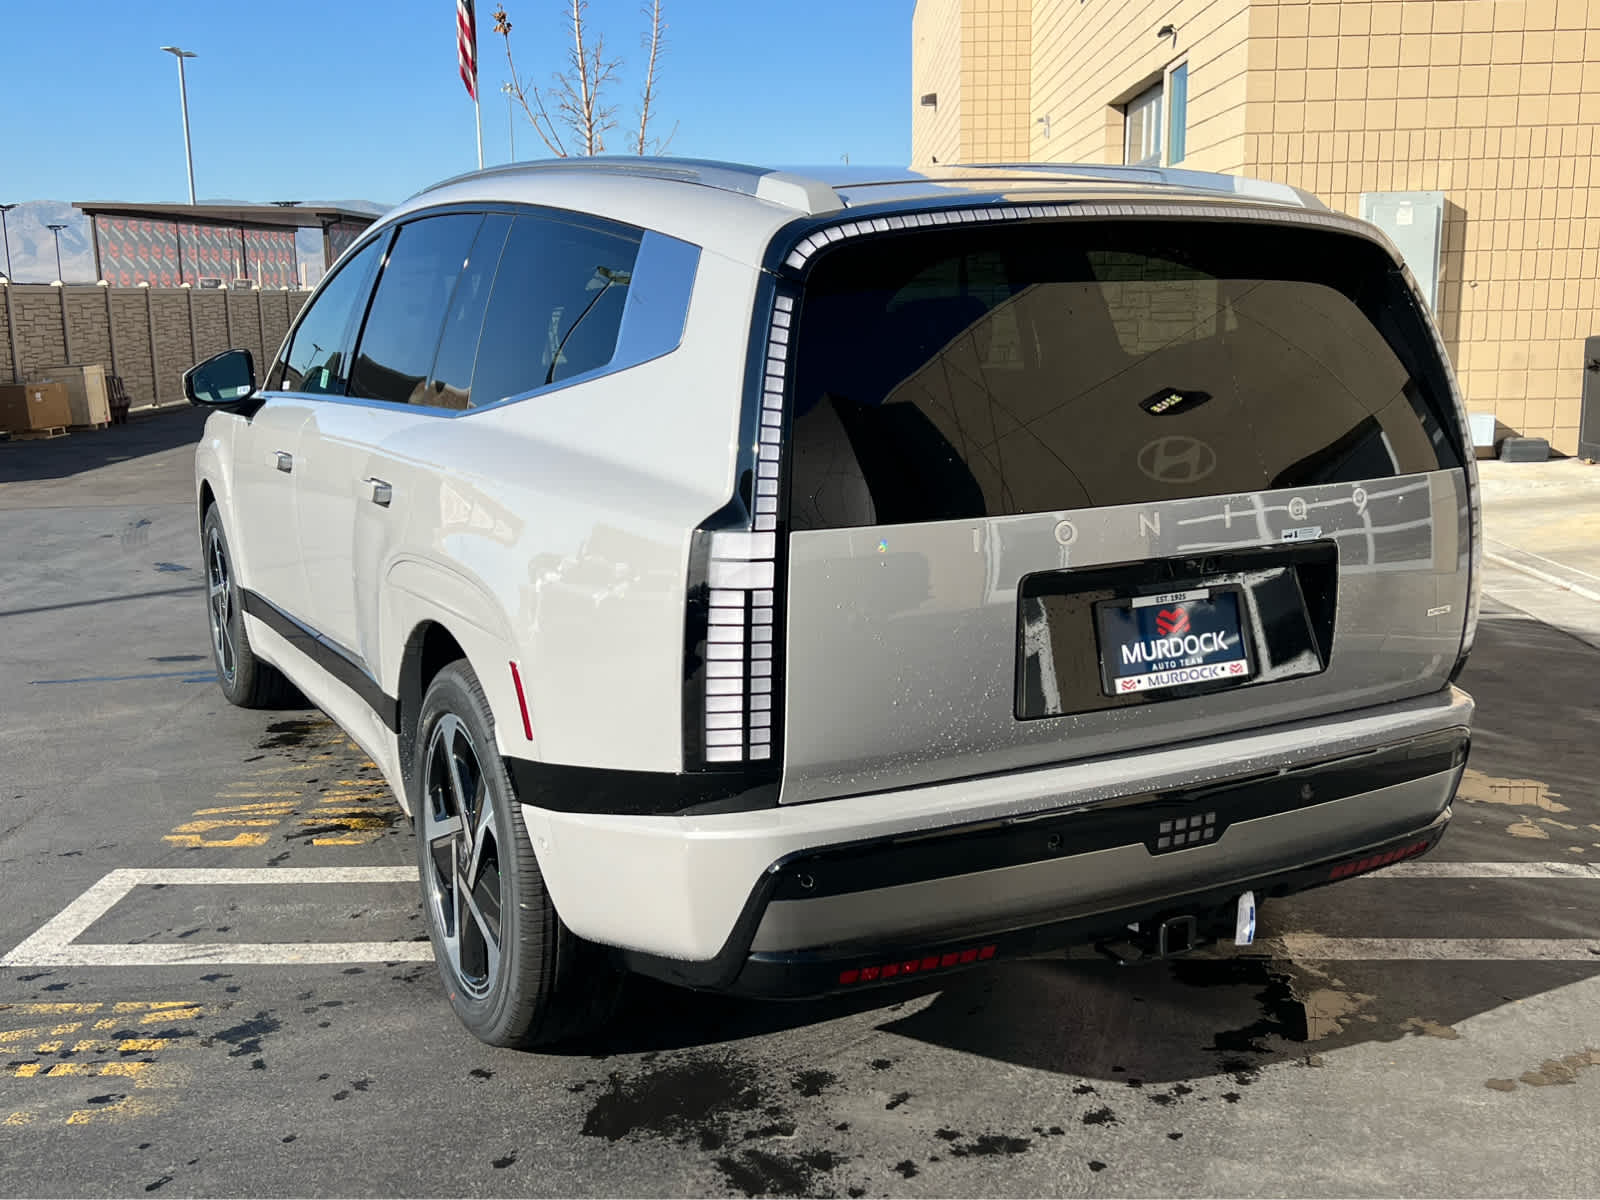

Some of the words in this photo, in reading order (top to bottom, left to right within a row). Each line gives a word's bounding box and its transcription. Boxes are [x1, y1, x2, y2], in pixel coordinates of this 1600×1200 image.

[1170, 592, 1187, 602] 1925
[1120, 630, 1230, 665] MURDOCK
[1151, 660, 1177, 672] AUTO
[1179, 656, 1204, 668] TEAM
[1147, 665, 1220, 688] MURDOCK
